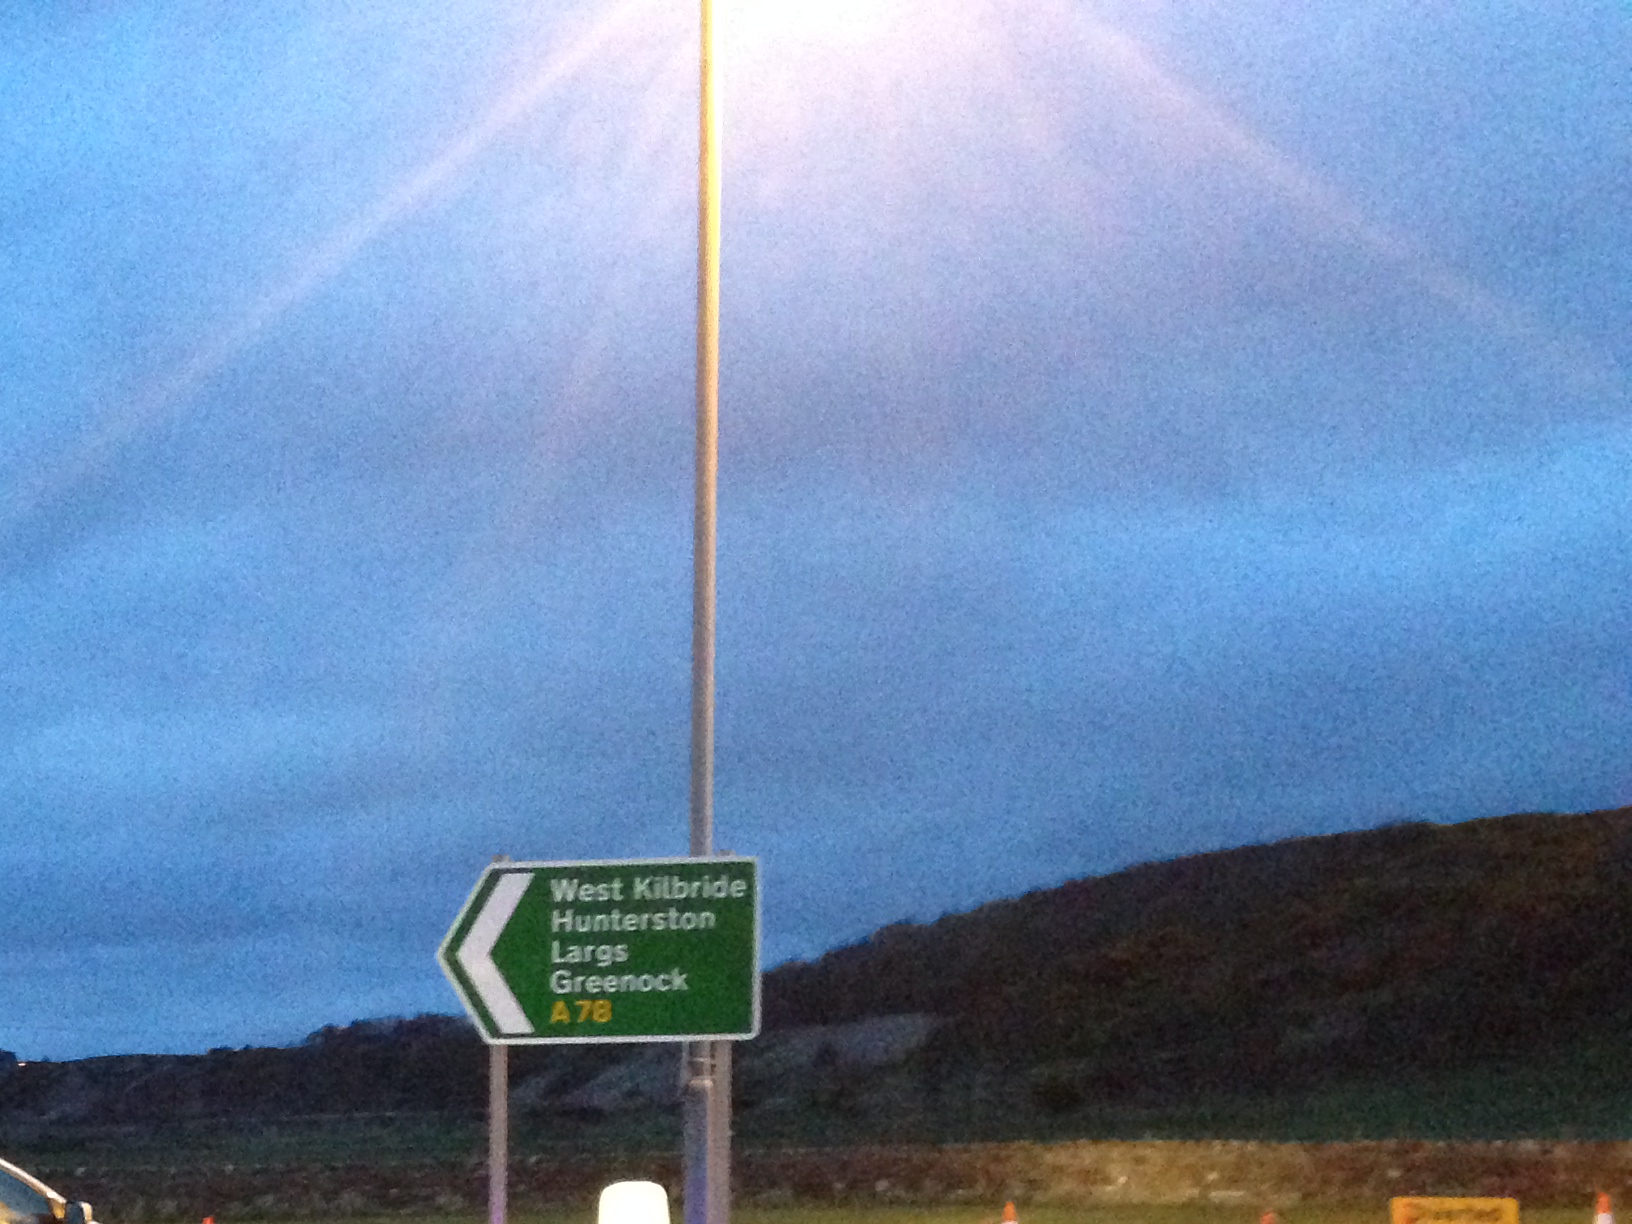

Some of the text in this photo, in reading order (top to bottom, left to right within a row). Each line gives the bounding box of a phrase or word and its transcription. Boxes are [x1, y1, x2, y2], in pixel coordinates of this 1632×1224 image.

[550, 875, 747, 902] West Kilbride
[551, 908, 716, 932] Hunterston
[551, 940, 629, 967] Largs
[550, 967, 689, 994] Greenock
